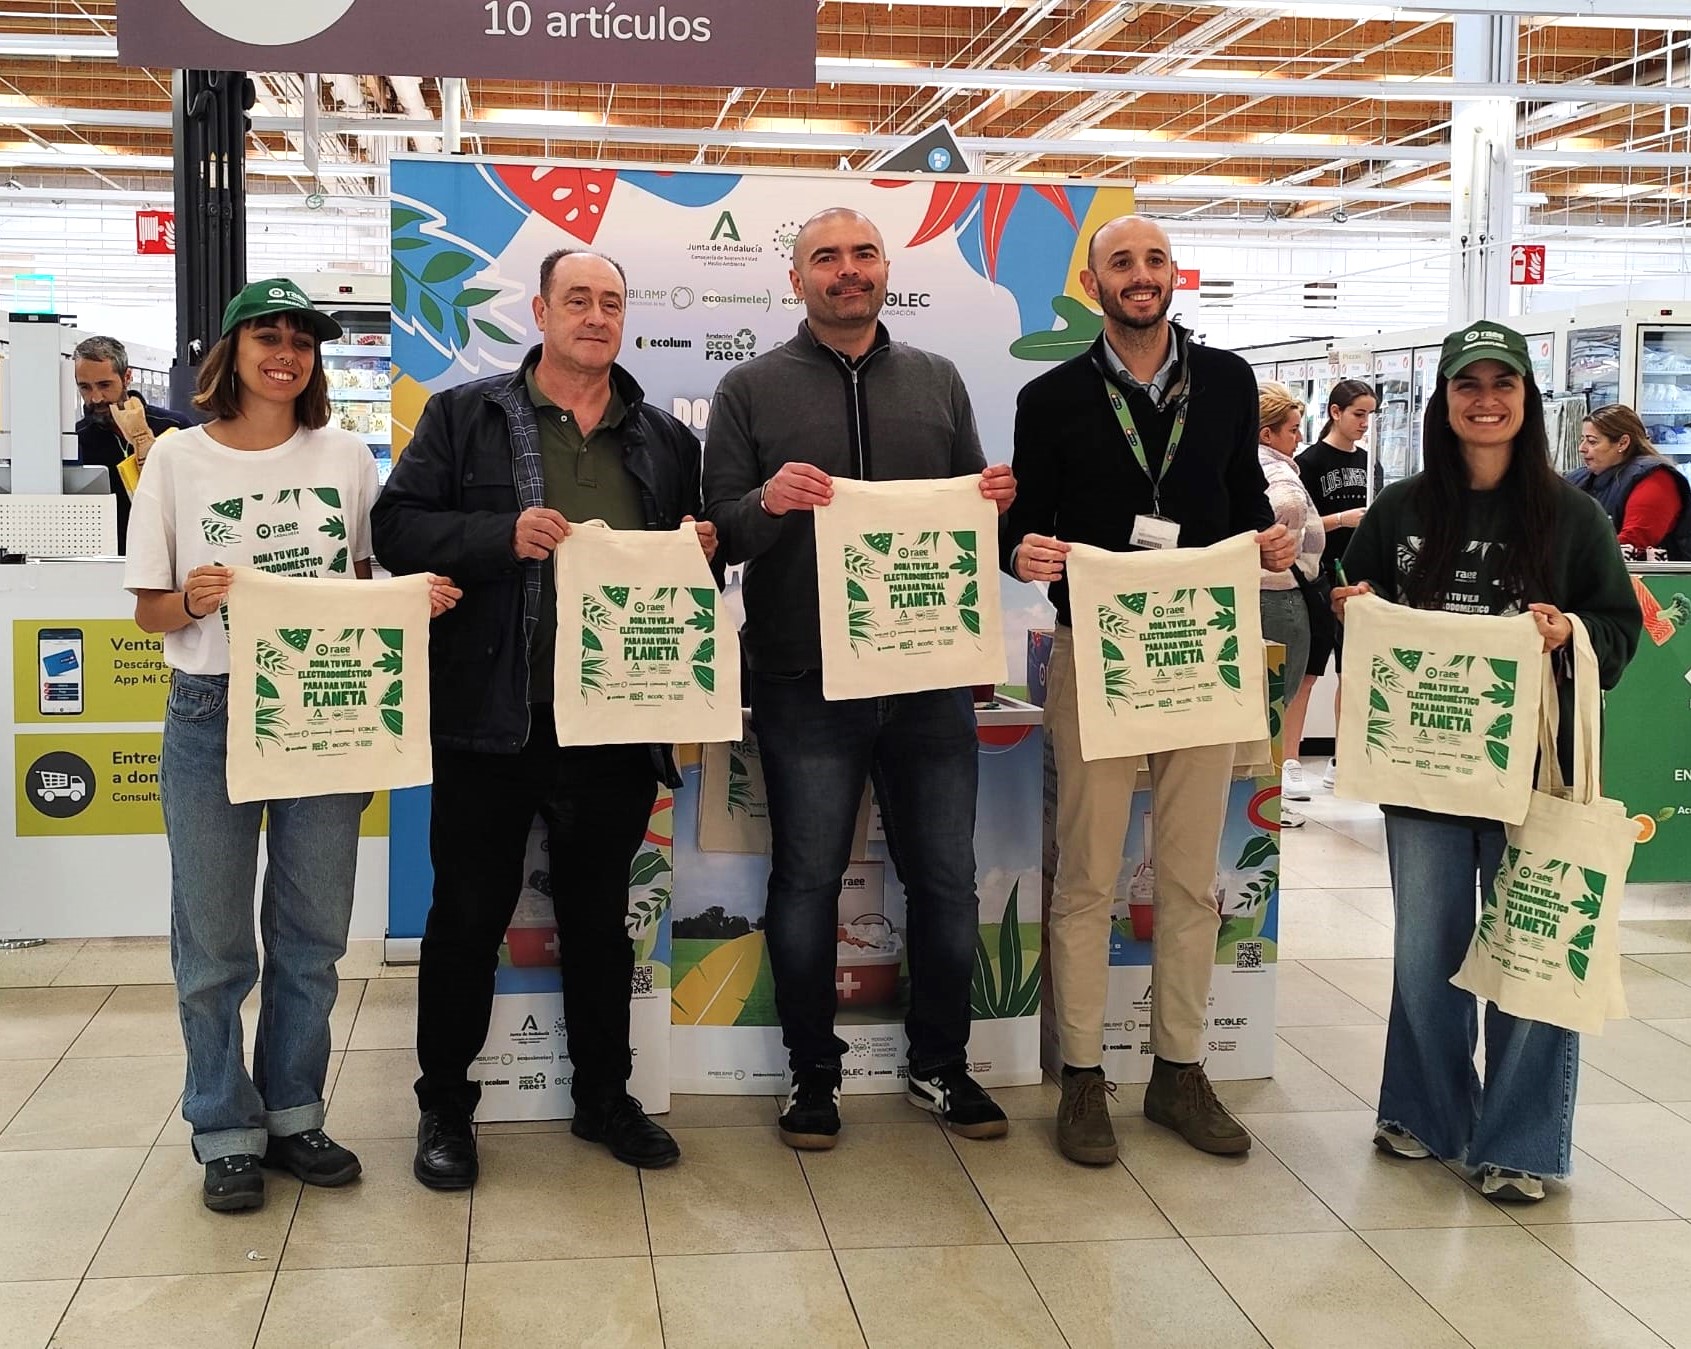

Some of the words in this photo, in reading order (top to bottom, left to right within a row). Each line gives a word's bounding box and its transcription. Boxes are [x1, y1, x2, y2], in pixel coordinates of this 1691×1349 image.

[485, 1, 531, 35] 10
[547, 2, 711, 41] artículos
[686, 244, 710, 253] Junta
[712, 244, 722, 252] de
[723, 243, 763, 253] Andalucía
[650, 337, 692, 348] ecolum
[706, 341, 732, 350] eco
[272, 521, 298, 534] raee
[253, 553, 274, 564] DONA
[274, 550, 285, 560] TU
[287, 546, 310, 558] VIEJO
[910, 549, 928, 557] raee
[894, 563, 911, 571] DONA
[912, 562, 921, 570] TU
[921, 562, 939, 570] VIEJO
[884, 572, 949, 582] ELECTRODOMÉSTICO
[1455, 570, 1478, 579] raee
[889, 584, 906, 592] PARA
[906, 583, 920, 591] DAR
[936, 582, 945, 590] AL
[890, 592, 946, 609] PLANETA
[1451, 592, 1461, 602] TU
[1166, 606, 1185, 614] raee
[629, 617, 647, 625] DONA
[648, 617, 656, 625] TU
[657, 617, 674, 625] VIEJO
[1149, 621, 1166, 630] DONA
[1168, 620, 1176, 628] TU
[1177, 619, 1196, 628] VIEJO
[620, 626, 685, 635] ELECTRODOMÉSTICO
[1139, 629, 1207, 641] ELECTRODOMÉSTICO
[110, 637, 164, 653] Ventaj
[624, 637, 641, 646] PARA
[642, 637, 655, 645] DAR
[656, 637, 671, 645] VIDA
[672, 637, 680, 645] AL
[1145, 643, 1163, 652] PARA
[1163, 642, 1178, 650] DAR
[1178, 641, 1194, 649] VIDA
[1194, 639, 1204, 648] AL
[330, 645, 350, 654] raee
[624, 646, 679, 661] PLANETA
[1146, 648, 1204, 668] PLANETA
[309, 660, 330, 668] DONA
[331, 660, 341, 668] TU
[342, 660, 361, 668] VIEJO
[298, 669, 372, 679] ELECTRODOMÉSTICO
[1438, 670, 1459, 679] raee
[114, 675, 139, 686] App
[142, 674, 156, 684] Mi
[303, 682, 324, 690] PARA
[324, 682, 340, 690] DAR
[340, 681, 357, 689] VIDA
[1419, 682, 1437, 691] DONA
[1438, 683, 1448, 691] TU
[1449, 685, 1469, 694] VIEJO
[303, 691, 367, 707] PLANETA
[1407, 690, 1479, 706] ELECTRODOMÉSTICO
[1411, 702, 1430, 712] PARA
[1430, 704, 1445, 713] DAR
[1446, 706, 1464, 715] VIDA
[1464, 708, 1473, 716] AL
[1410, 711, 1472, 733] PLANETA
[112, 774, 122, 784] a
[843, 878, 866, 886] raee
[1532, 872, 1553, 883] raee
[1530, 884, 1539, 894] TU
[1540, 888, 1560, 900] VIEJO
[1504, 908, 1557, 939] PLANETA
[1551, 914, 1561, 923] AL
[1214, 1018, 1248, 1026] ECOLEC
